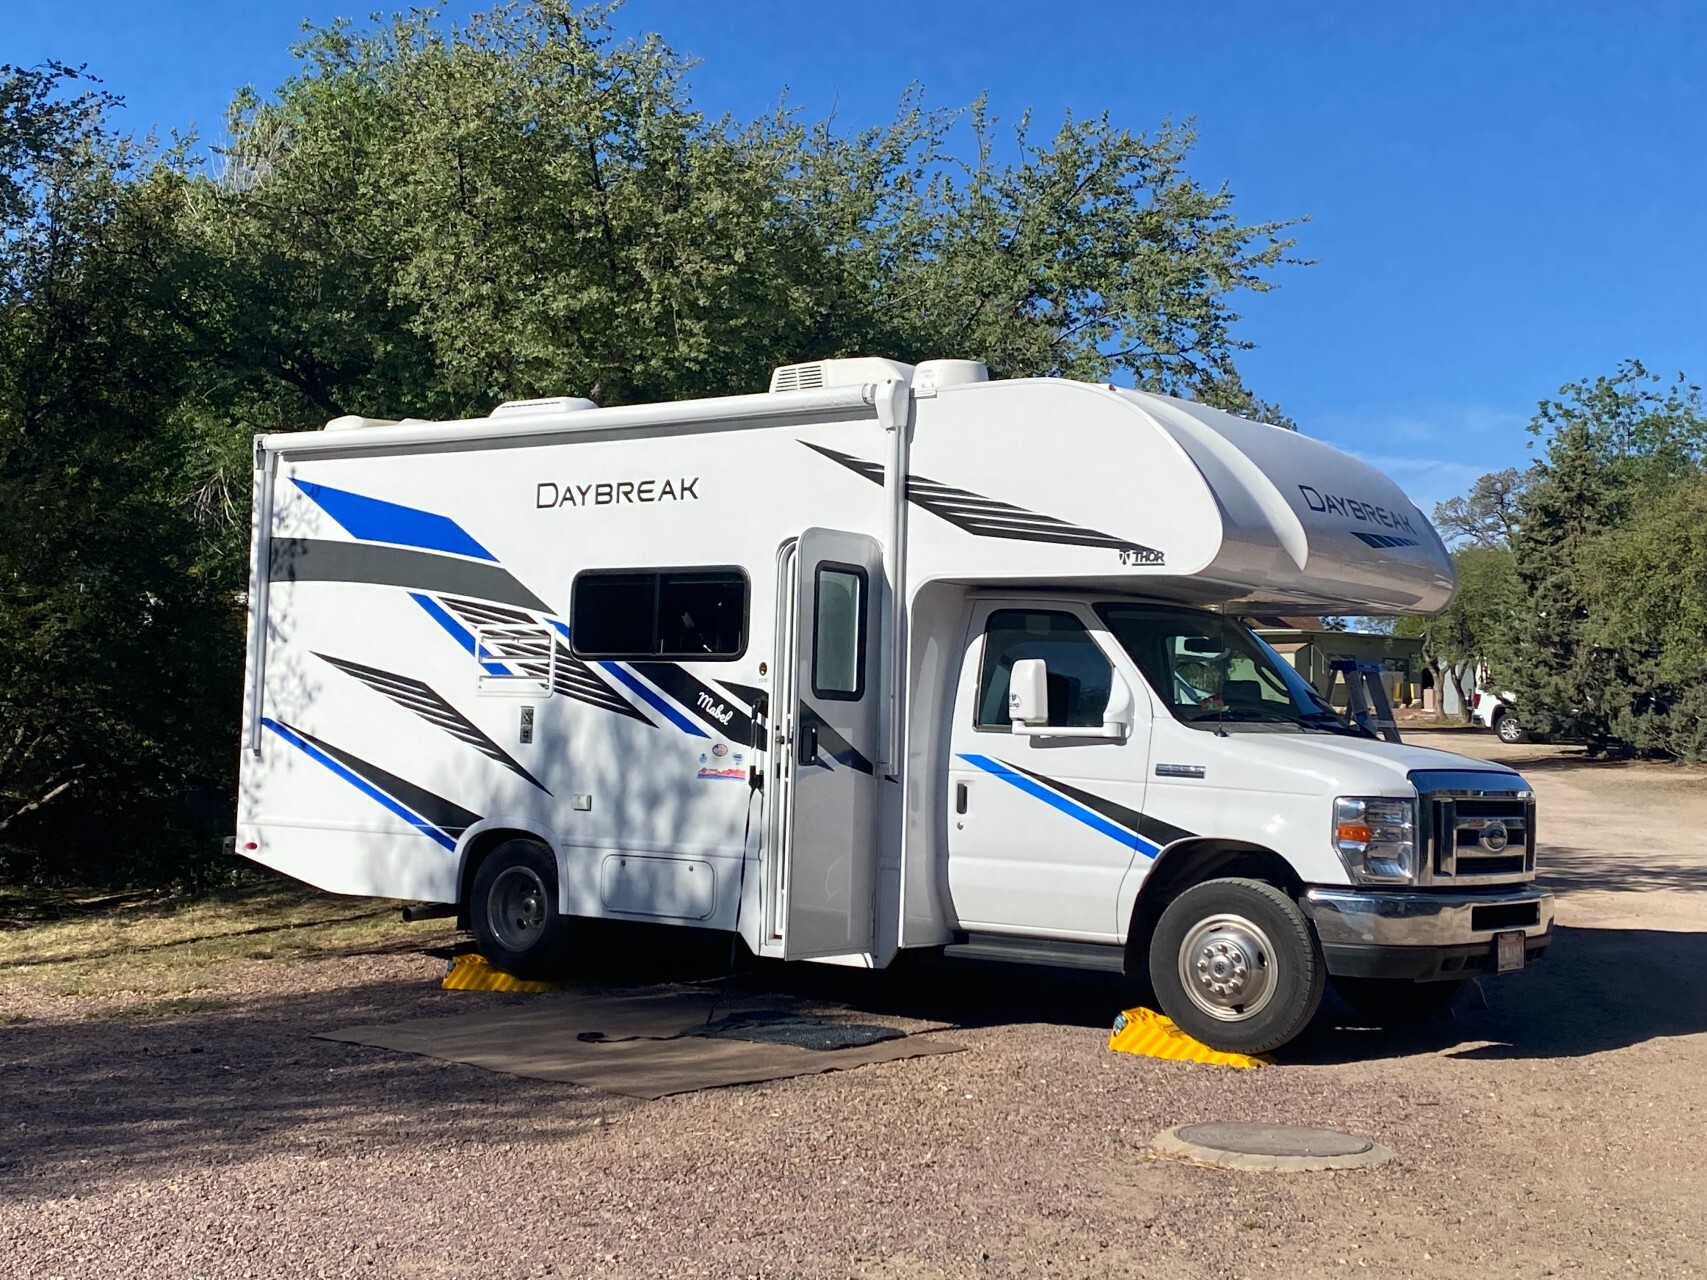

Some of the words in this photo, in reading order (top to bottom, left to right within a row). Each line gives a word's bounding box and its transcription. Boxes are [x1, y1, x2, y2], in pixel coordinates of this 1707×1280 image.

[536, 477, 699, 509] DAYBREAK
[1298, 484, 1417, 536] DAYBREAK
[1132, 550, 1165, 563] THOR
[697, 691, 733, 725] Mabel
